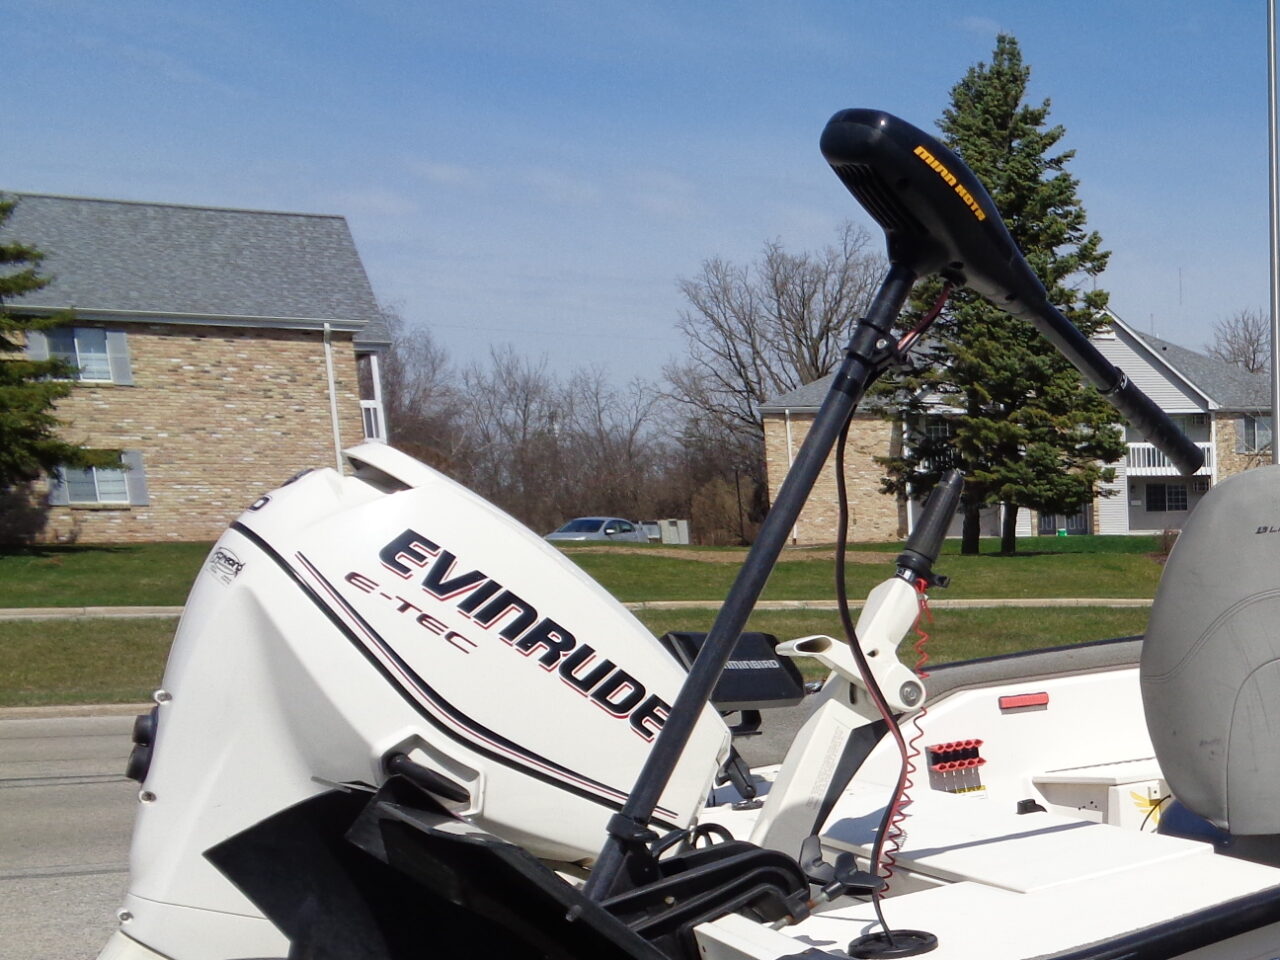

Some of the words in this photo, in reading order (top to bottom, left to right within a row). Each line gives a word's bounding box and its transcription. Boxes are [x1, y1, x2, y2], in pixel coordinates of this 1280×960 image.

[345, 571, 478, 654] E-TEC
[379, 529, 673, 743] EVINRUDE
[723, 659, 780, 670] MINBIRD
